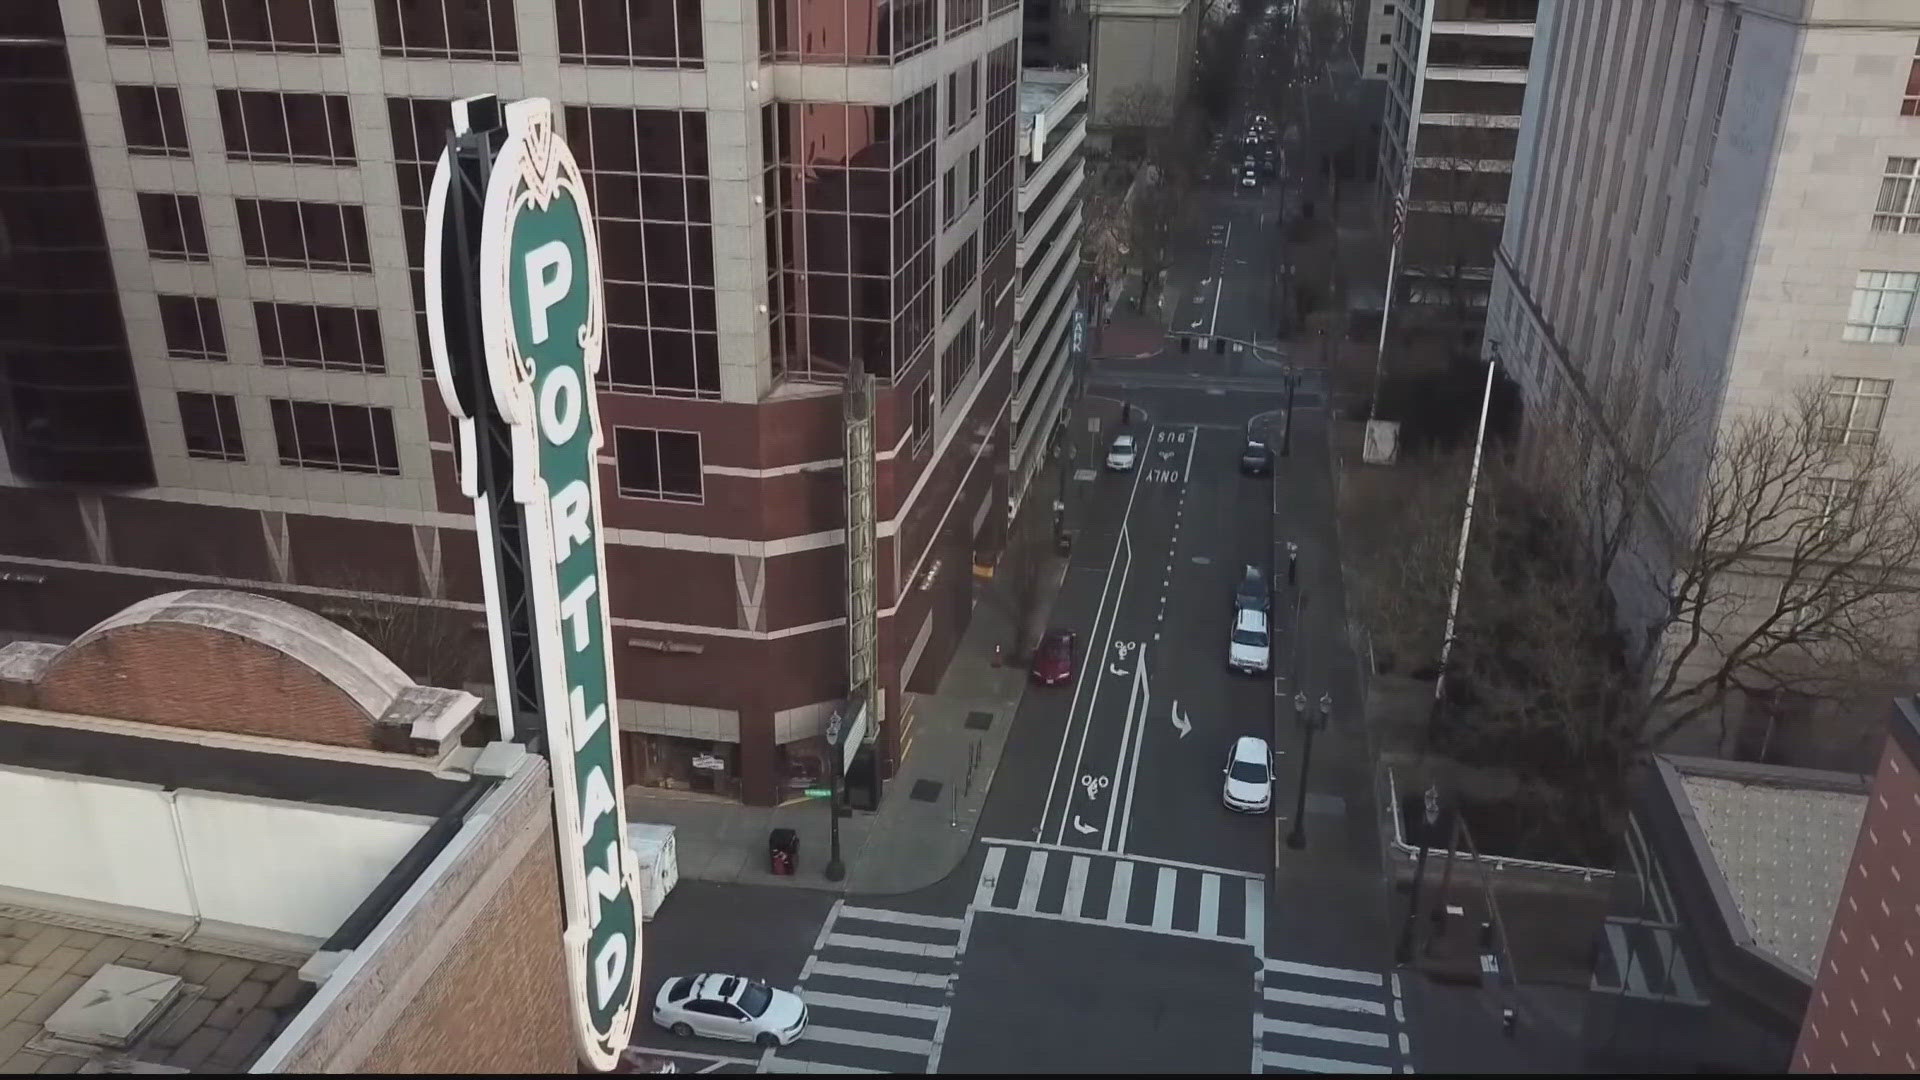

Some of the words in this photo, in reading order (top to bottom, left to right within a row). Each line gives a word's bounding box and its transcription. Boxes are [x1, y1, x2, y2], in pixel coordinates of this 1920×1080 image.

[1073, 312, 1083, 352] PARK
[1158, 431, 1185, 443] BUS
[1145, 470, 1178, 483] ONLY
[525, 239, 627, 1011] PORTLAND
